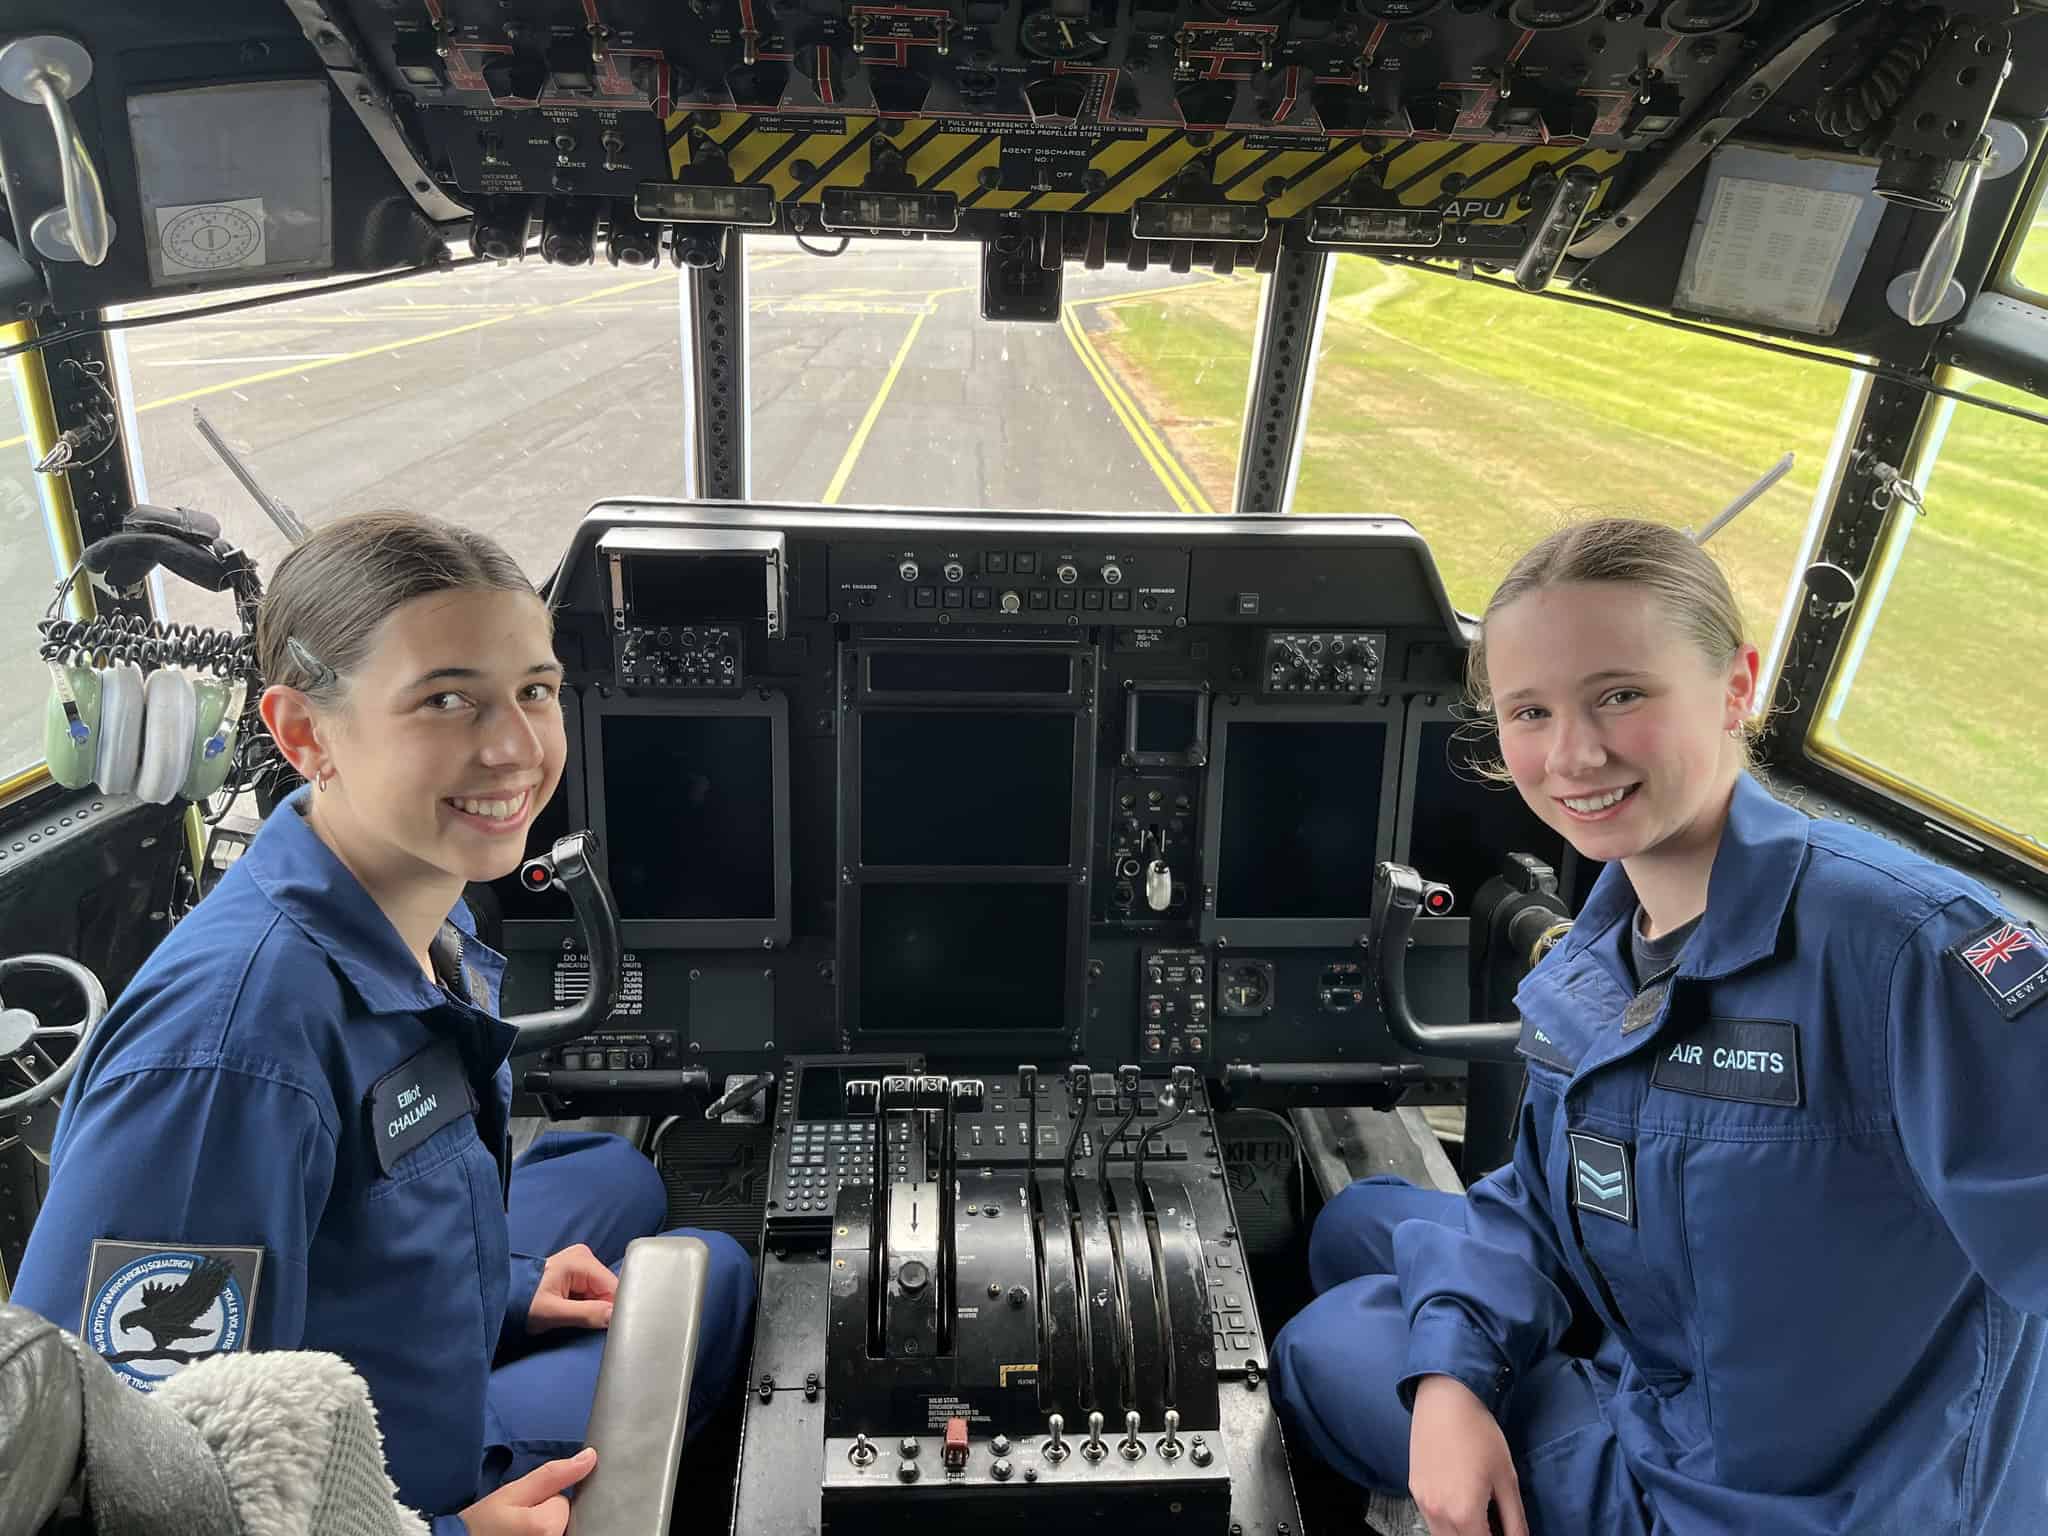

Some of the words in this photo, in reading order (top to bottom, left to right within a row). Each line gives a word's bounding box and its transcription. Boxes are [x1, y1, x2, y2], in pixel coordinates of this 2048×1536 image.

[1442, 201, 1505, 218] APU
[563, 953, 577, 961] DO
[2006, 983, 2035, 1006] NEW
[1668, 1043, 1704, 1066] AIR
[1713, 1047, 1785, 1074] CADETS
[894, 1079, 905, 1092] 2
[927, 1079, 938, 1091] 3
[962, 1084, 972, 1096] 4
[1076, 1074, 1088, 1091] 2
[1125, 1074, 1137, 1091] 3
[1179, 1076, 1191, 1092] 4
[397, 1084, 422, 1109] Elliot
[388, 1094, 438, 1138] CHALMAN
[1224, 1141, 1294, 1162] KHEED
